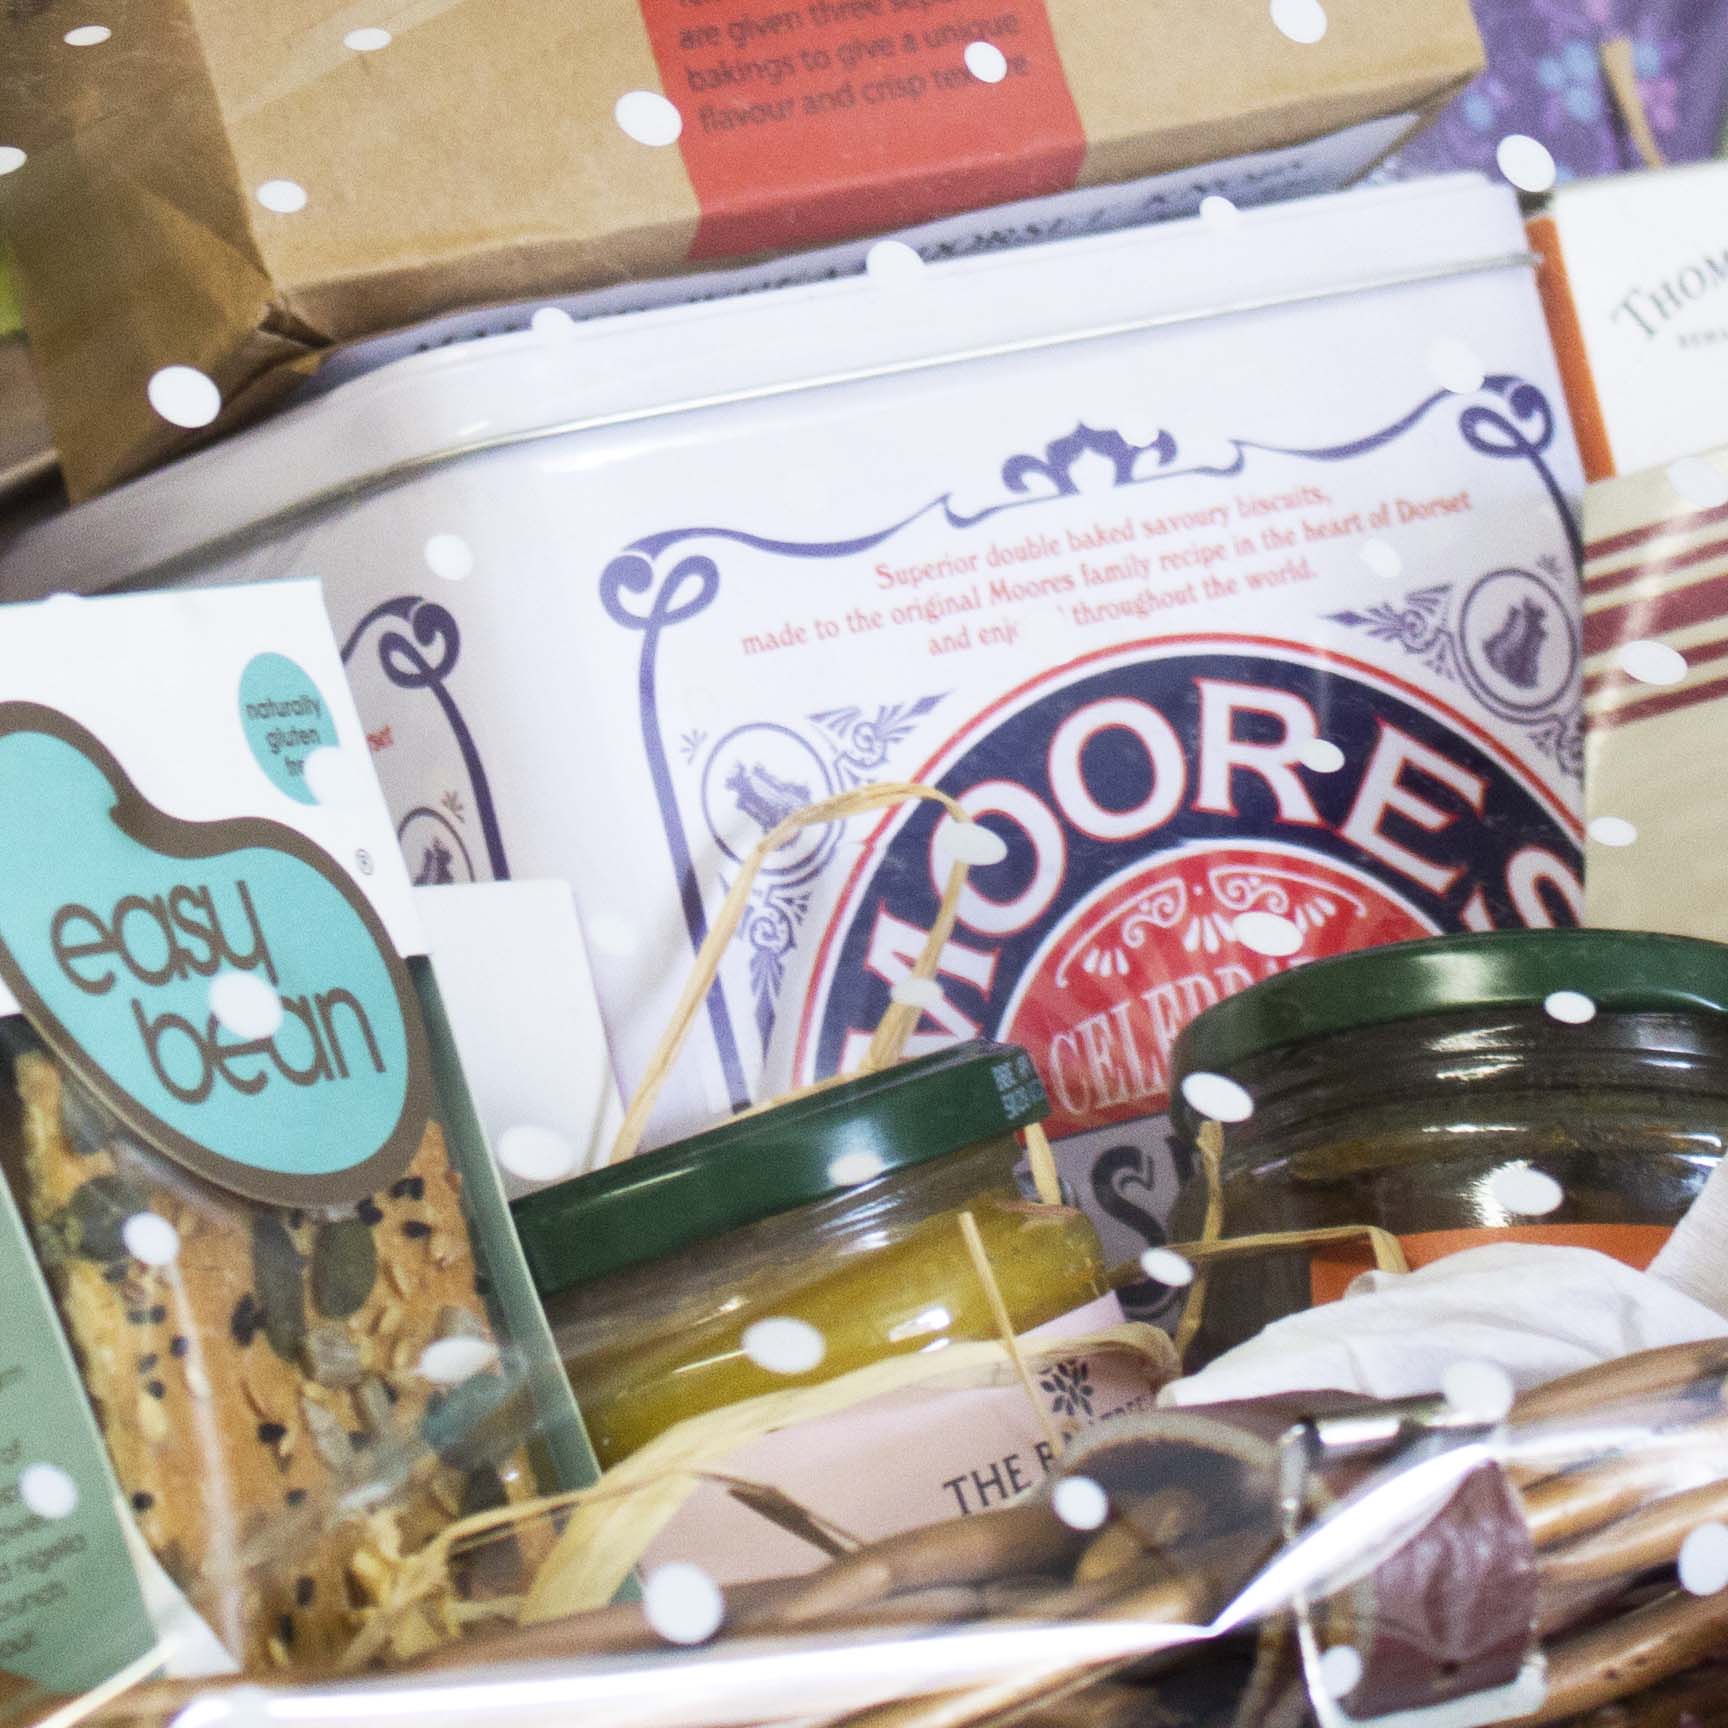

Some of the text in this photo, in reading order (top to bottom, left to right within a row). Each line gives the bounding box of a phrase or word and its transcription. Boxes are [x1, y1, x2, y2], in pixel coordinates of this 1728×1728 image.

[680, 24, 720, 50] are
[728, 7, 803, 57] given
[686, 50, 796, 95] bakings
[801, 46, 831, 75] to
[836, 32, 897, 74] give
[923, 10, 1019, 53] unique
[699, 96, 797, 134] flavour
[802, 82, 855, 117] and
[861, 75, 926, 110] crisp
[741, 489, 1473, 656] made to the original Moores family recipe in the heart of Dorset
[874, 484, 1333, 591] Superior double baked savoury biscuits,
[928, 622, 971, 656] and
[1072, 585, 1197, 627] throughout
[1201, 572, 1238, 601] the
[1246, 555, 1319, 590] world.
[245, 693, 323, 728] naturally
[265, 724, 323, 755] gluten
[50, 878, 280, 996] easy
[131, 984, 388, 1106] bean
[942, 1453, 1033, 1516] THE
